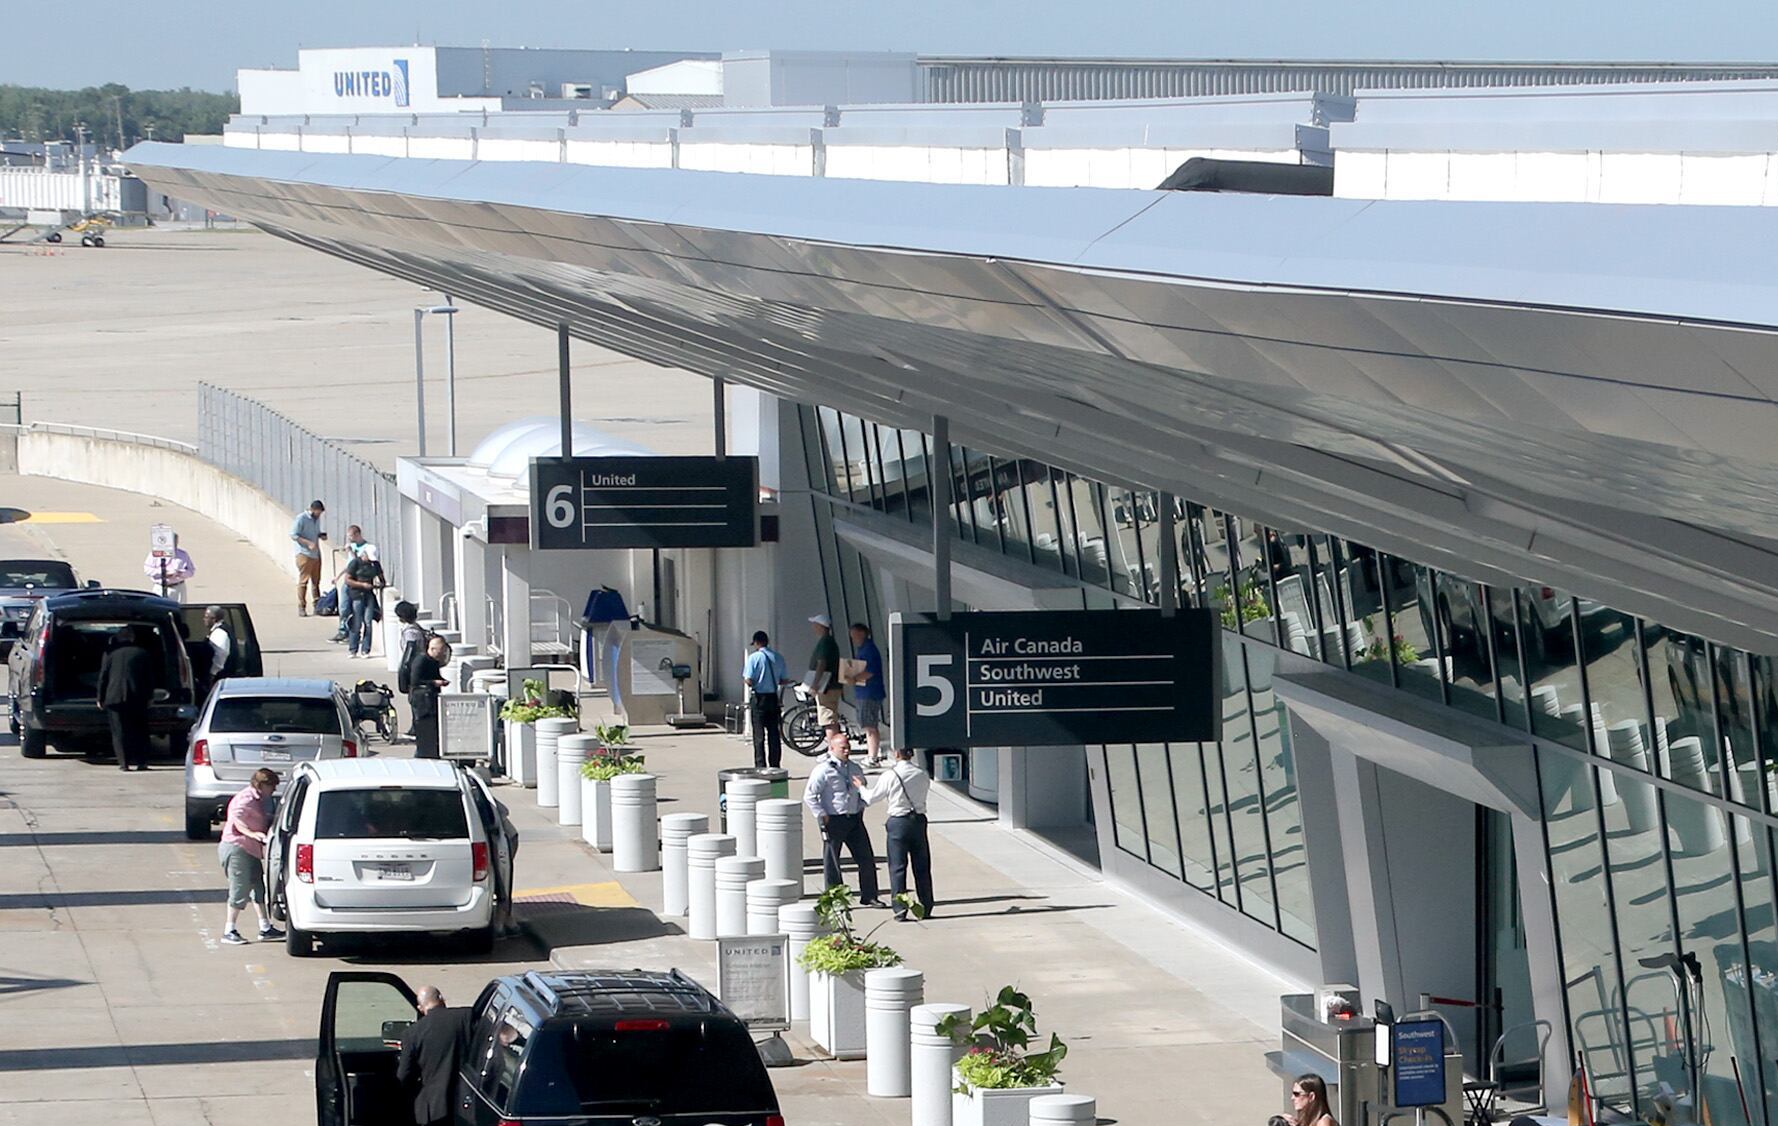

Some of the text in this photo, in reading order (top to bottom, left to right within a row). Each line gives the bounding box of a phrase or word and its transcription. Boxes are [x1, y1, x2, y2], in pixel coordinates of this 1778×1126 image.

[334, 72, 391, 97] UNITED
[592, 474, 636, 486] United
[545, 484, 575, 528] 6
[981, 637, 1083, 654] Air Canada
[980, 663, 1080, 681] Southwest
[916, 654, 955, 717] 5
[980, 689, 1043, 706] United
[1398, 1030, 1435, 1039] Southwest
